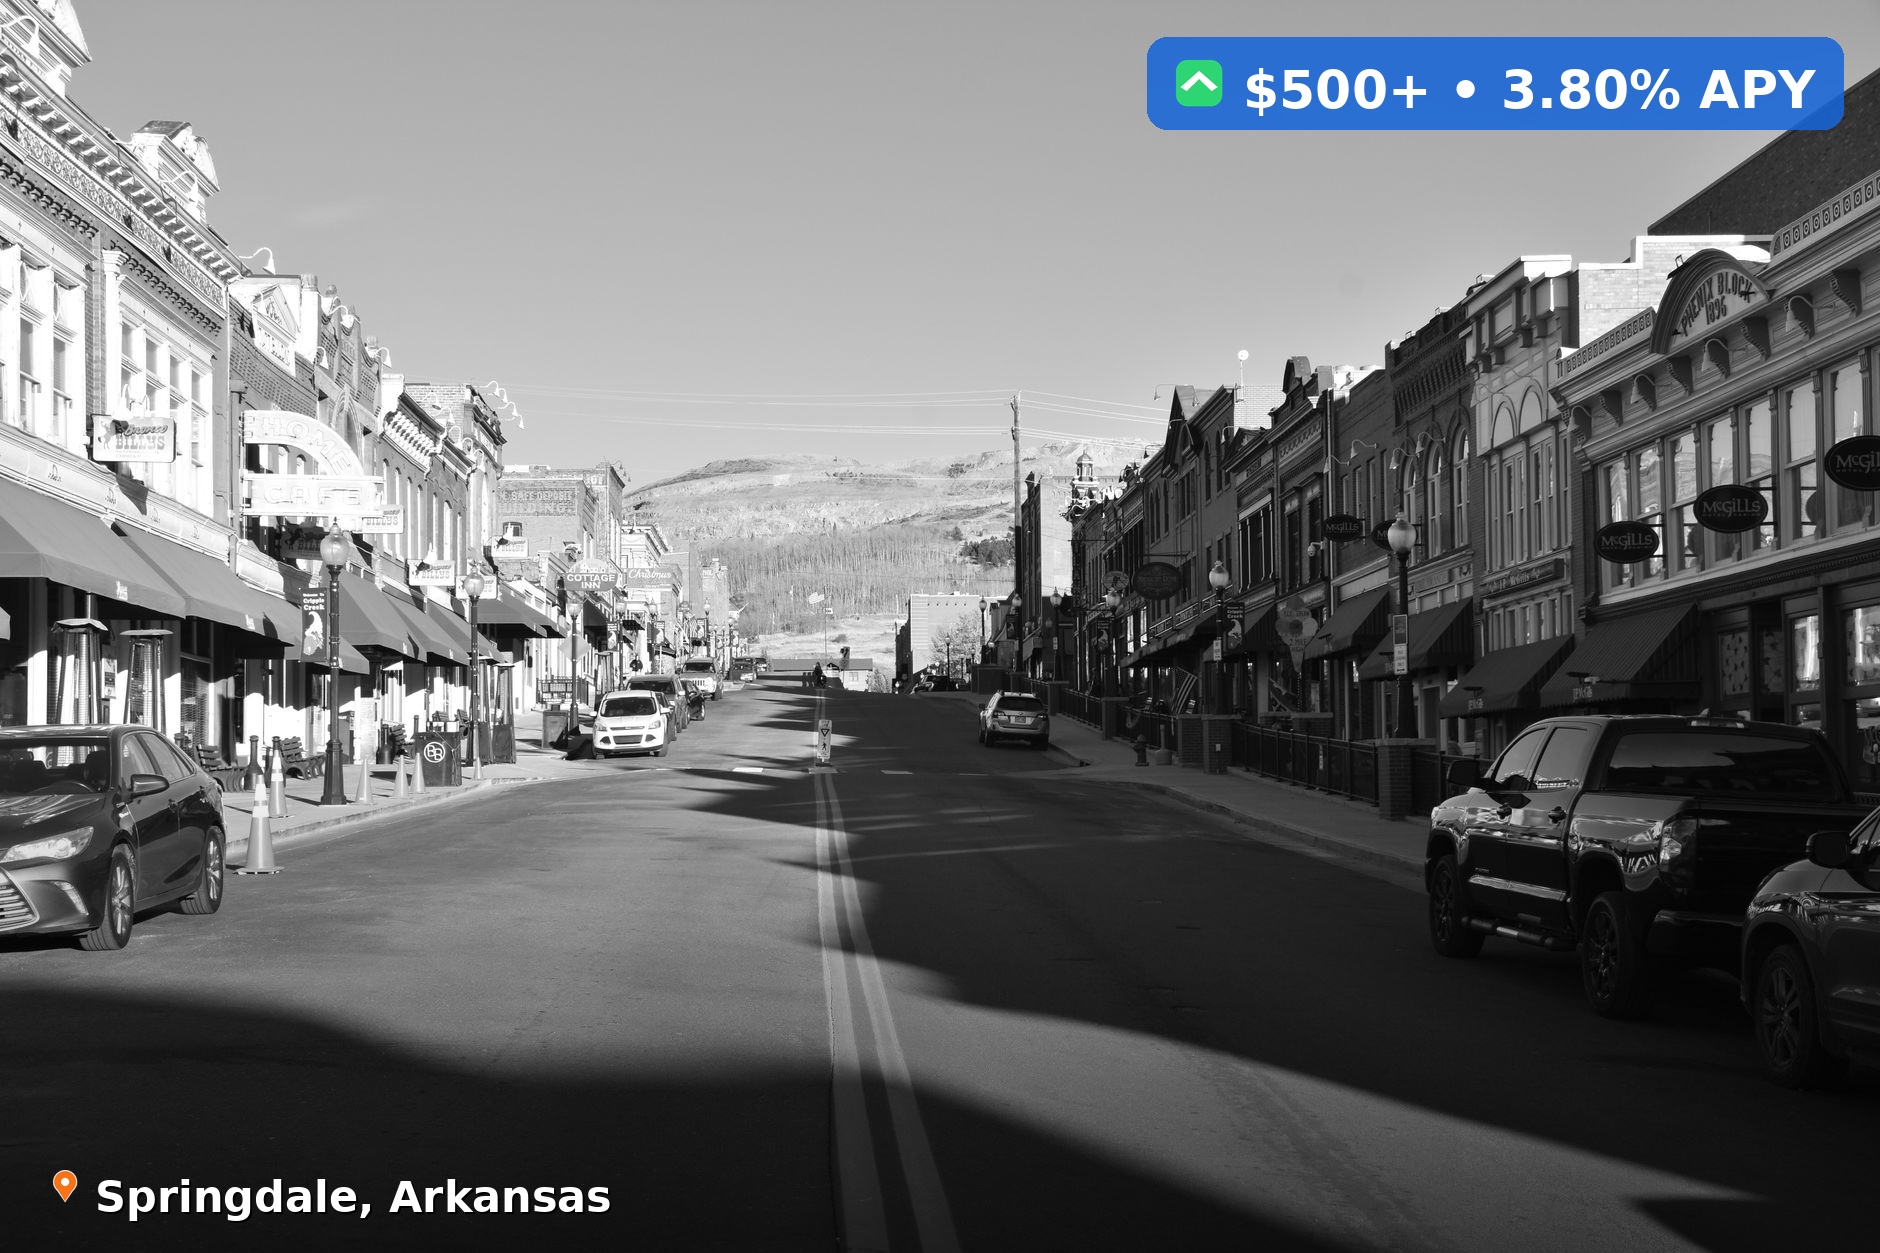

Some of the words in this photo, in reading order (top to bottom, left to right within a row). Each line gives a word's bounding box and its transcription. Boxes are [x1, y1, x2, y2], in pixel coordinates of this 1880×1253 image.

[1717, 272, 1753, 303] BLOCK
[1704, 295, 1727, 325] 1896
[262, 416, 352, 475] HOME
[264, 486, 361, 505] CAFE
[567, 573, 615, 582] COTTAGE
[581, 581, 601, 589] INN
